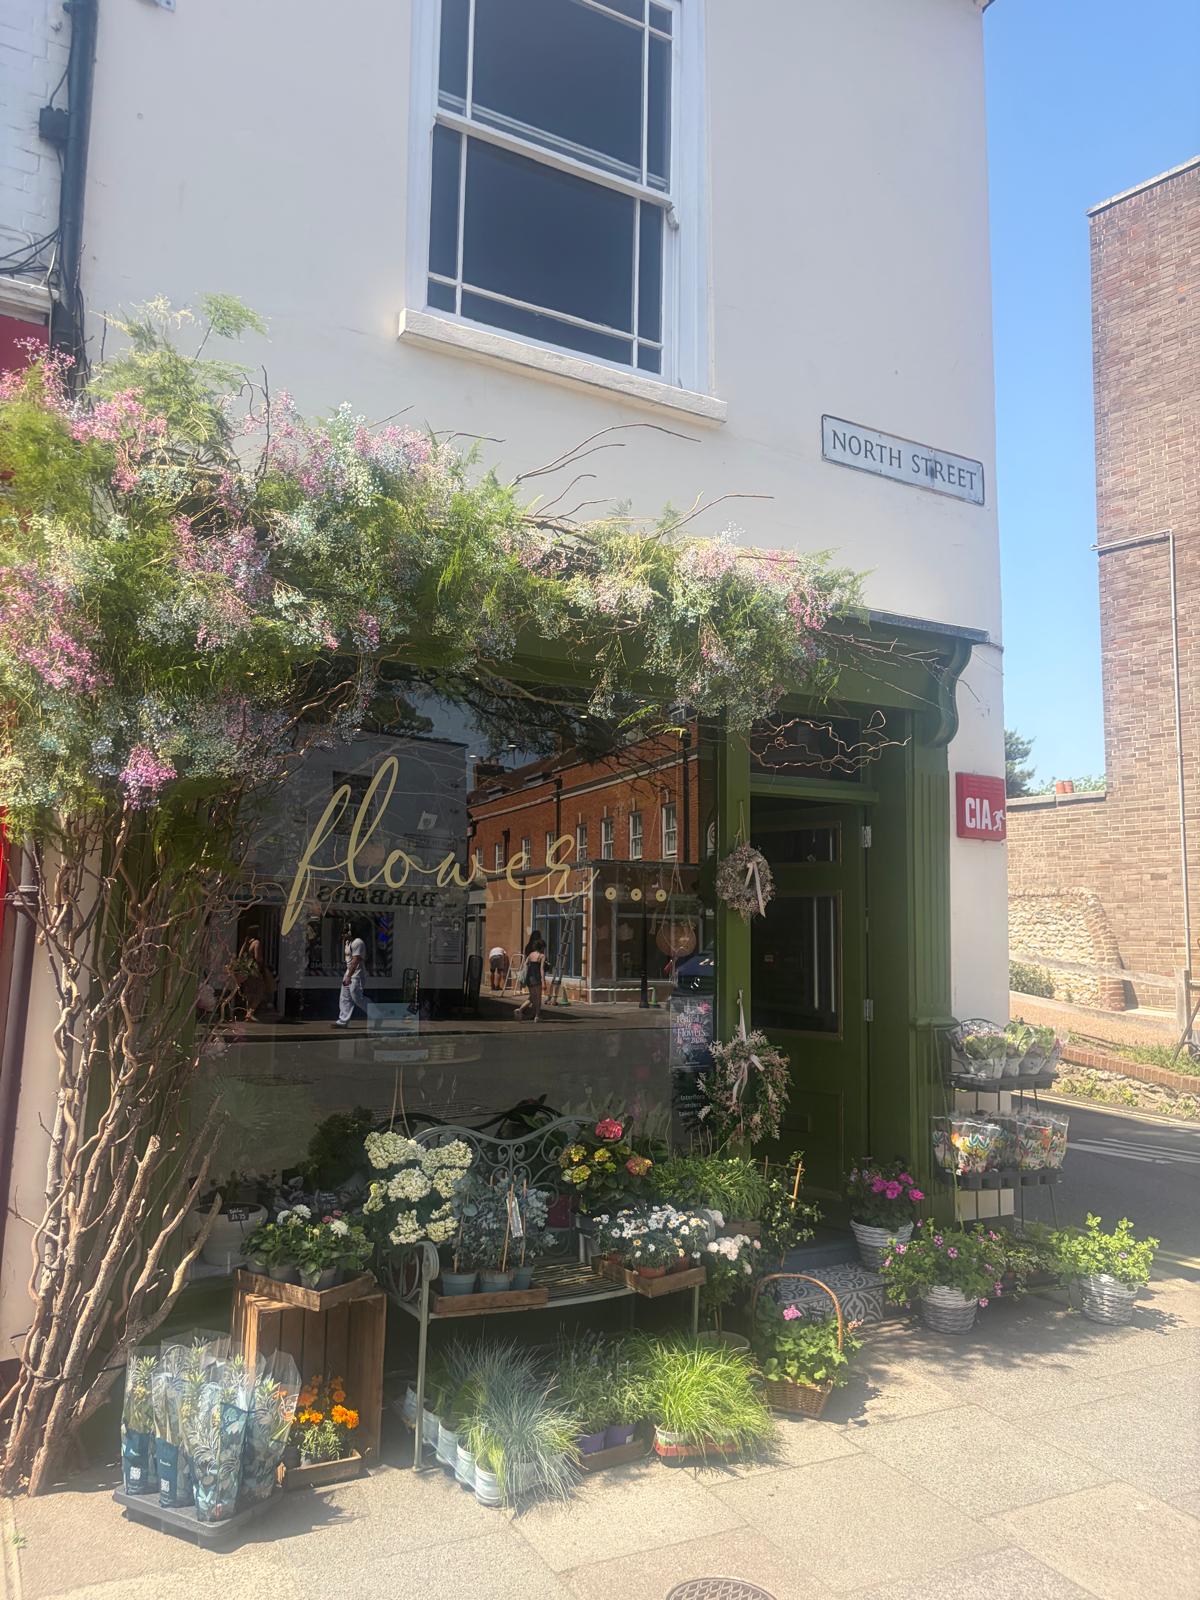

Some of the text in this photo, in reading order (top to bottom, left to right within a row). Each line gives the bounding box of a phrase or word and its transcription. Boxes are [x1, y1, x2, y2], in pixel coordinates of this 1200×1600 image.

[832, 429, 977, 490] NORTH STREET
[965, 797, 993, 831] CIA
